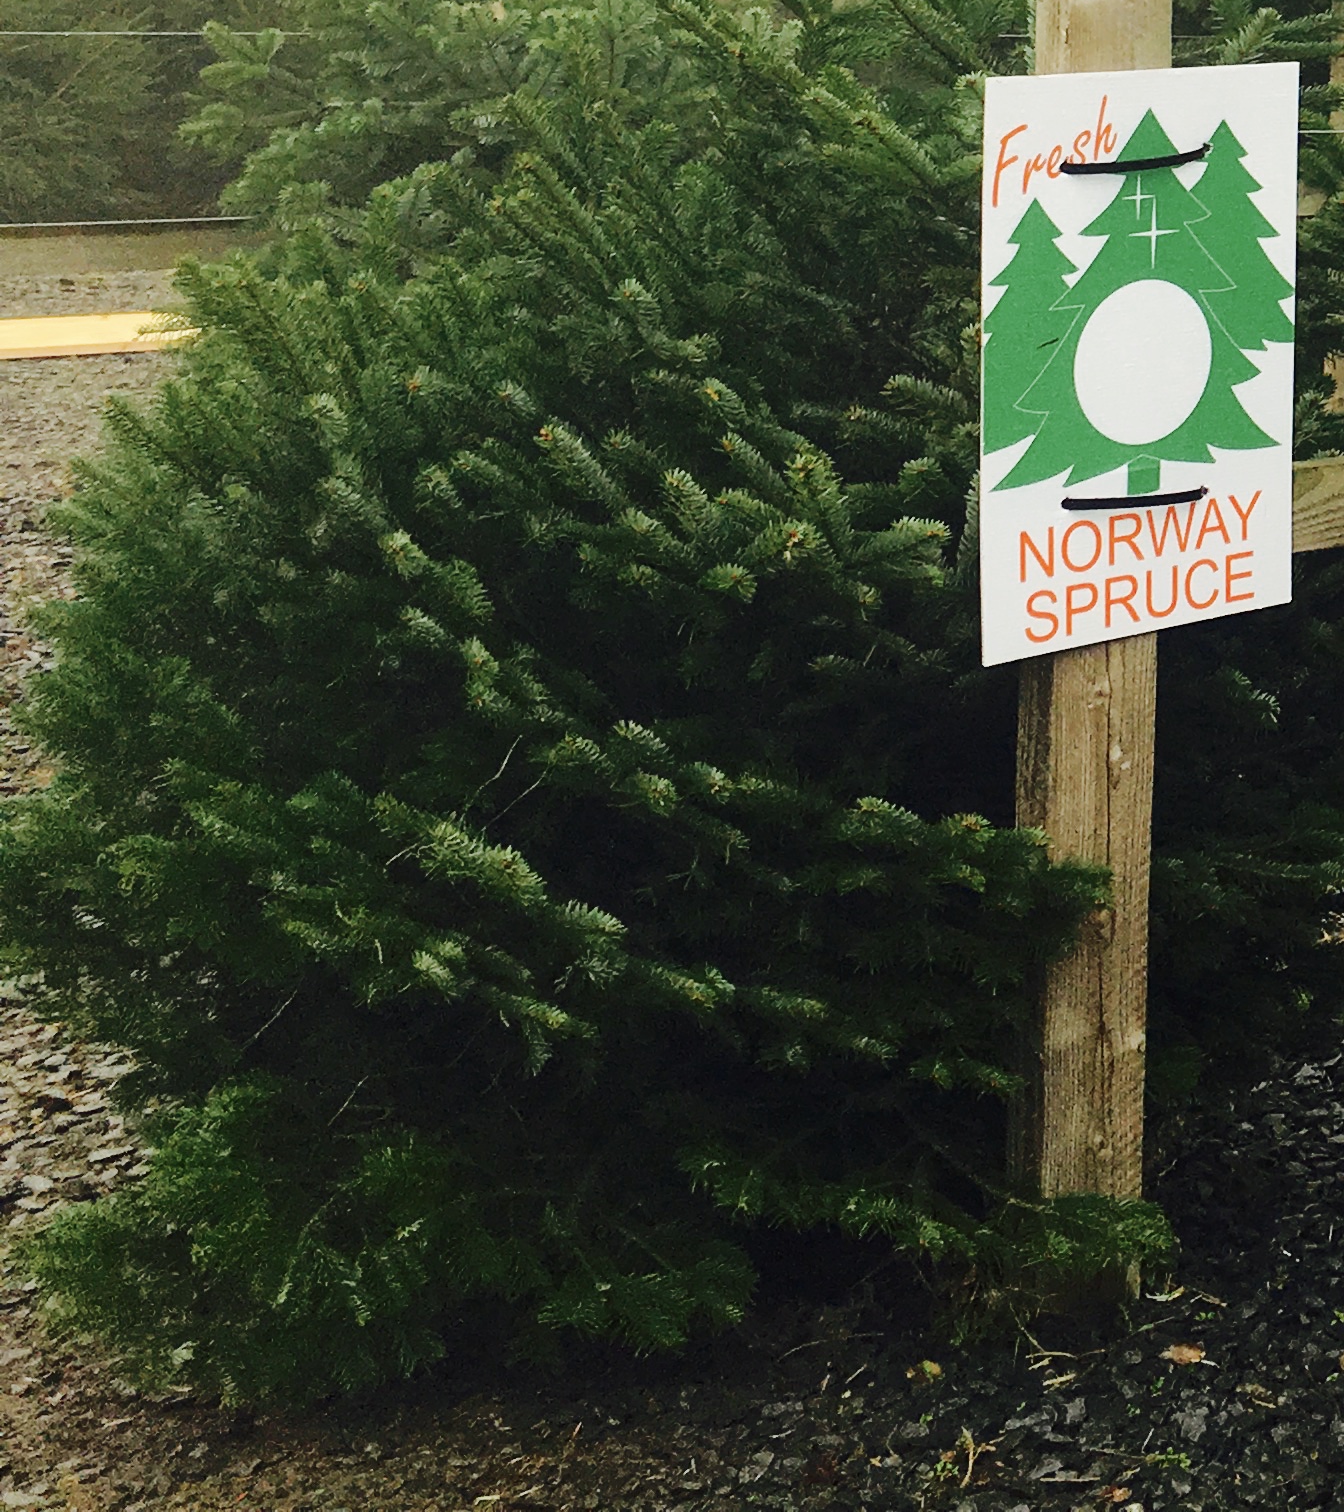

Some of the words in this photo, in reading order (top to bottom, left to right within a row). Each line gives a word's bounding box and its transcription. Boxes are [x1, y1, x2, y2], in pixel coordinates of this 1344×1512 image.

[991, 94, 1119, 209] Fresh
[1018, 490, 1262, 584] NORWAY
[1024, 550, 1256, 644] SPRUCE
